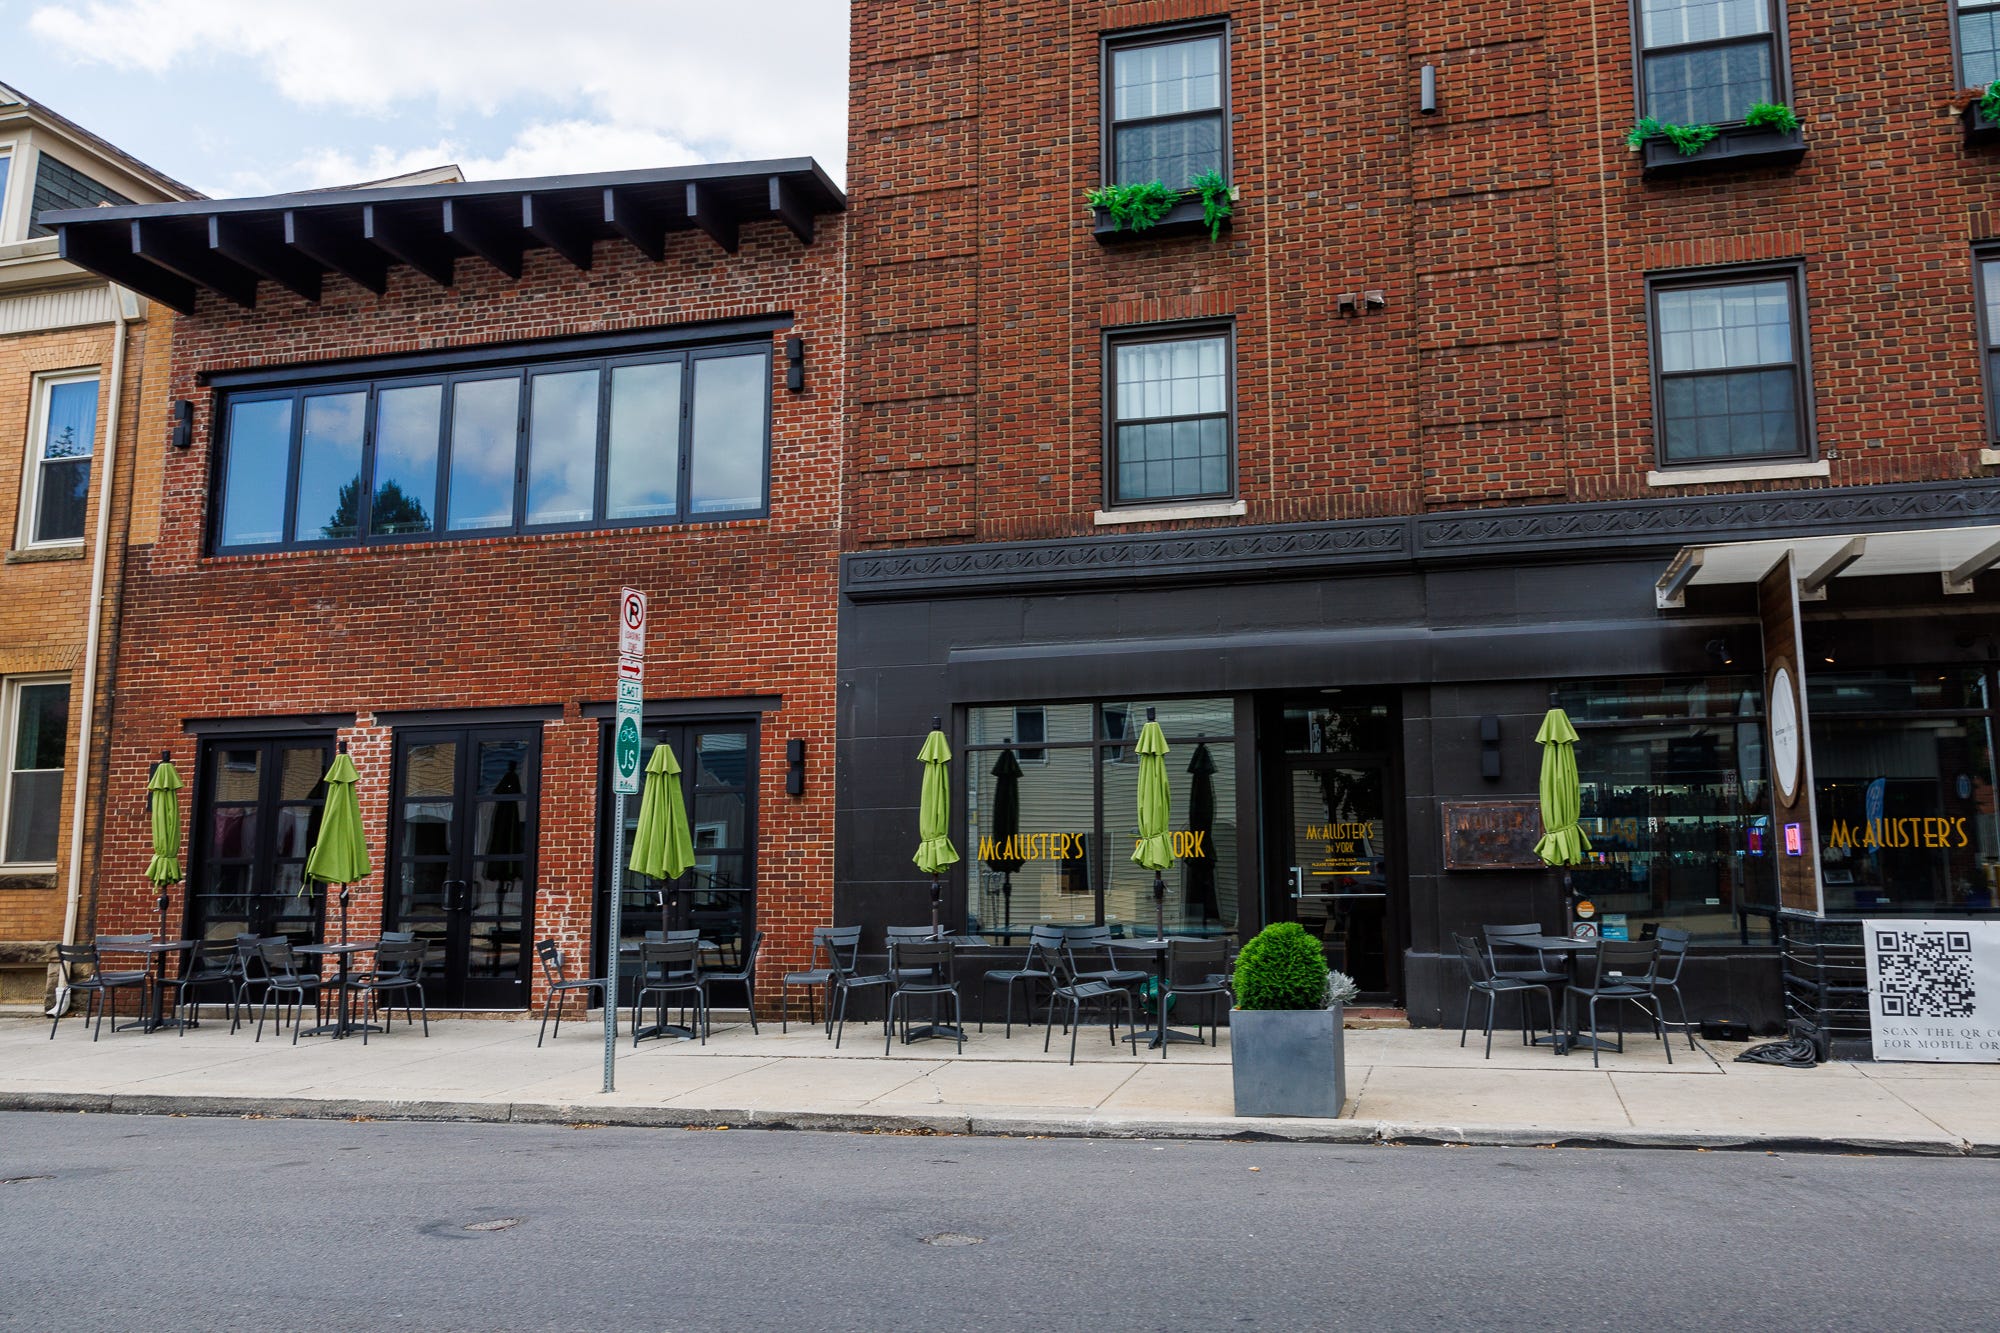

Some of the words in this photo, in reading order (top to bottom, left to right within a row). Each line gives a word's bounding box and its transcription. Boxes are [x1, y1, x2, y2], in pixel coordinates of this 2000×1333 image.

[621, 683, 639, 698] EAST
[621, 749, 635, 769] JS
[1306, 822, 1374, 840] McALLISTER'S
[1829, 816, 1968, 848] McALLISTER'S
[977, 832, 1085, 861] McALLISTER'S
[1168, 830, 1206, 858] ORK
[1336, 842, 1354, 853] YORK
[1882, 1027, 1919, 1037] SCAN
[1927, 1028, 1954, 1037] THE
[1960, 1029, 1981, 1039] QR
[1884, 1040, 1912, 1049] FOR
[1918, 1040, 1973, 1050] MOBILE
